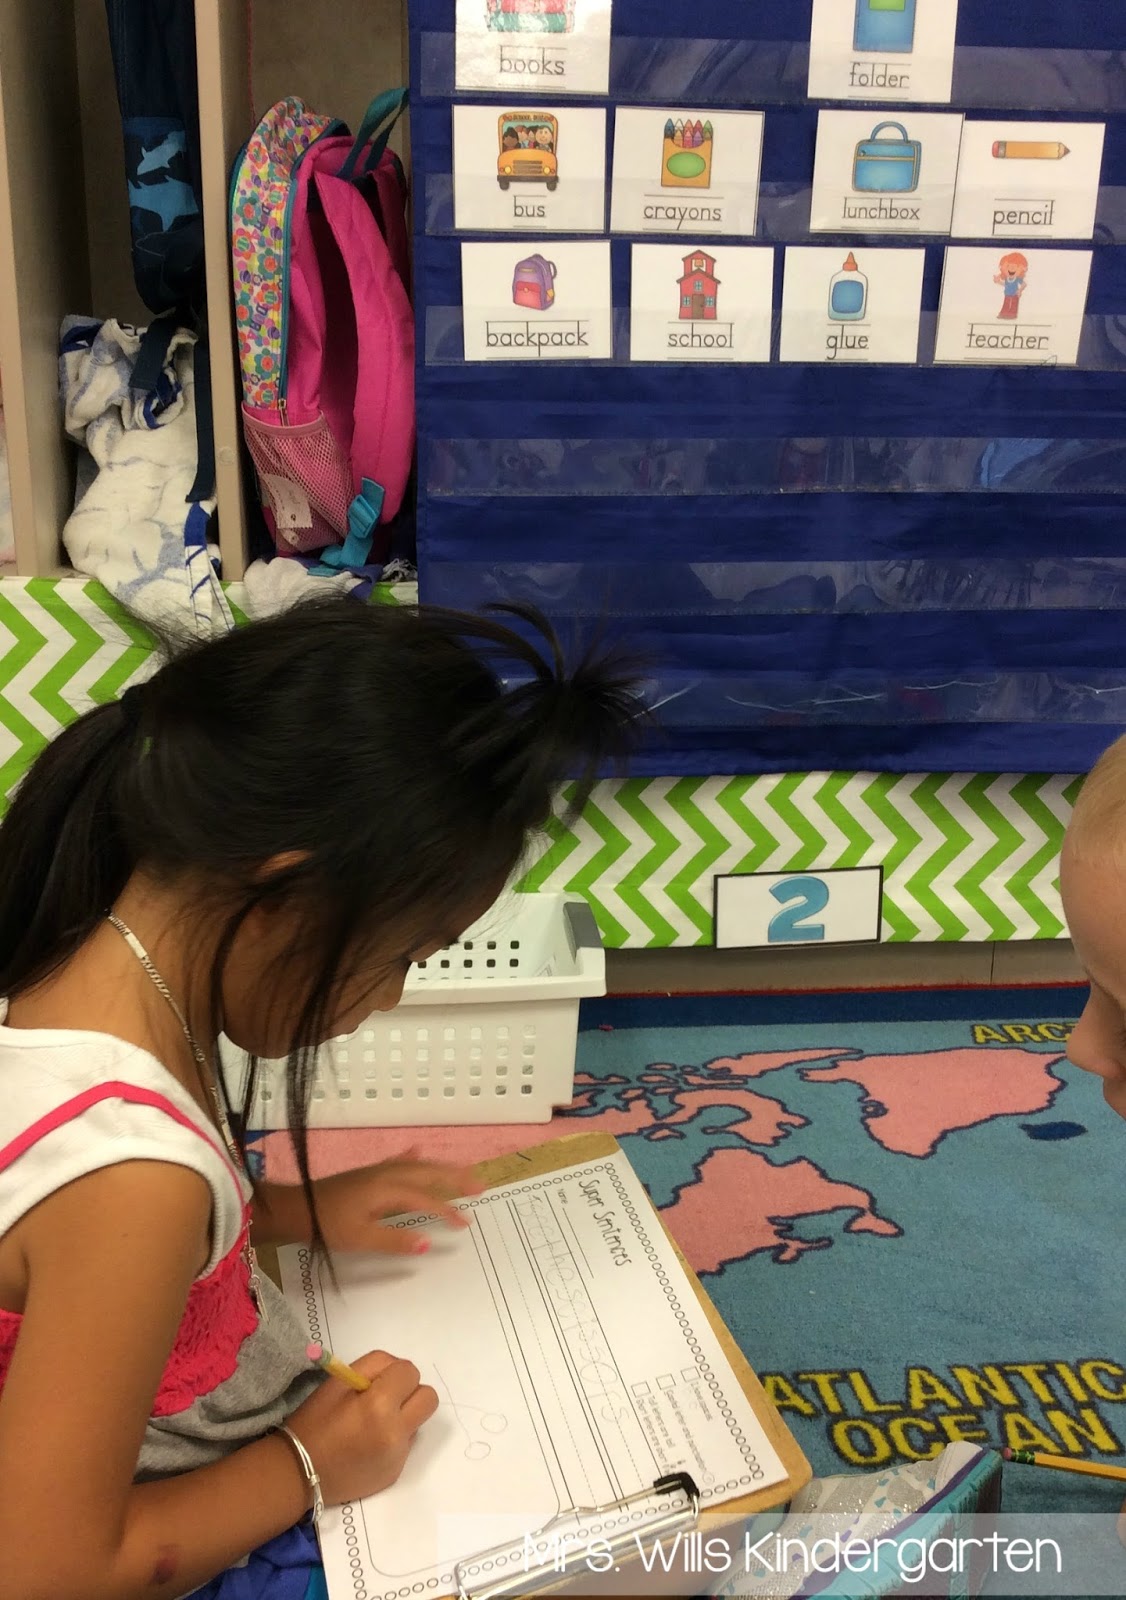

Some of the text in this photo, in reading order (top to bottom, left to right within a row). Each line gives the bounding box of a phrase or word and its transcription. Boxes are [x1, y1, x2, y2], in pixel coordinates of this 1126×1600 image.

[499, 45, 565, 76] books
[850, 63, 910, 89] folder
[513, 195, 546, 218] bus
[643, 204, 722, 231] crayons
[842, 197, 920, 221] lunchbox
[992, 200, 1055, 236] pencil
[486, 320, 589, 357] backpack
[667, 322, 733, 349] school
[826, 326, 869, 360] glue
[967, 324, 1049, 350] teacher
[768, 875, 829, 943] 2
[971, 1022, 1080, 1044] ARC
[578, 1178, 632, 1267] Super Sentences
[762, 1360, 1126, 1415] ATLANTIC
[833, 1409, 1121, 1465] OCEAN
